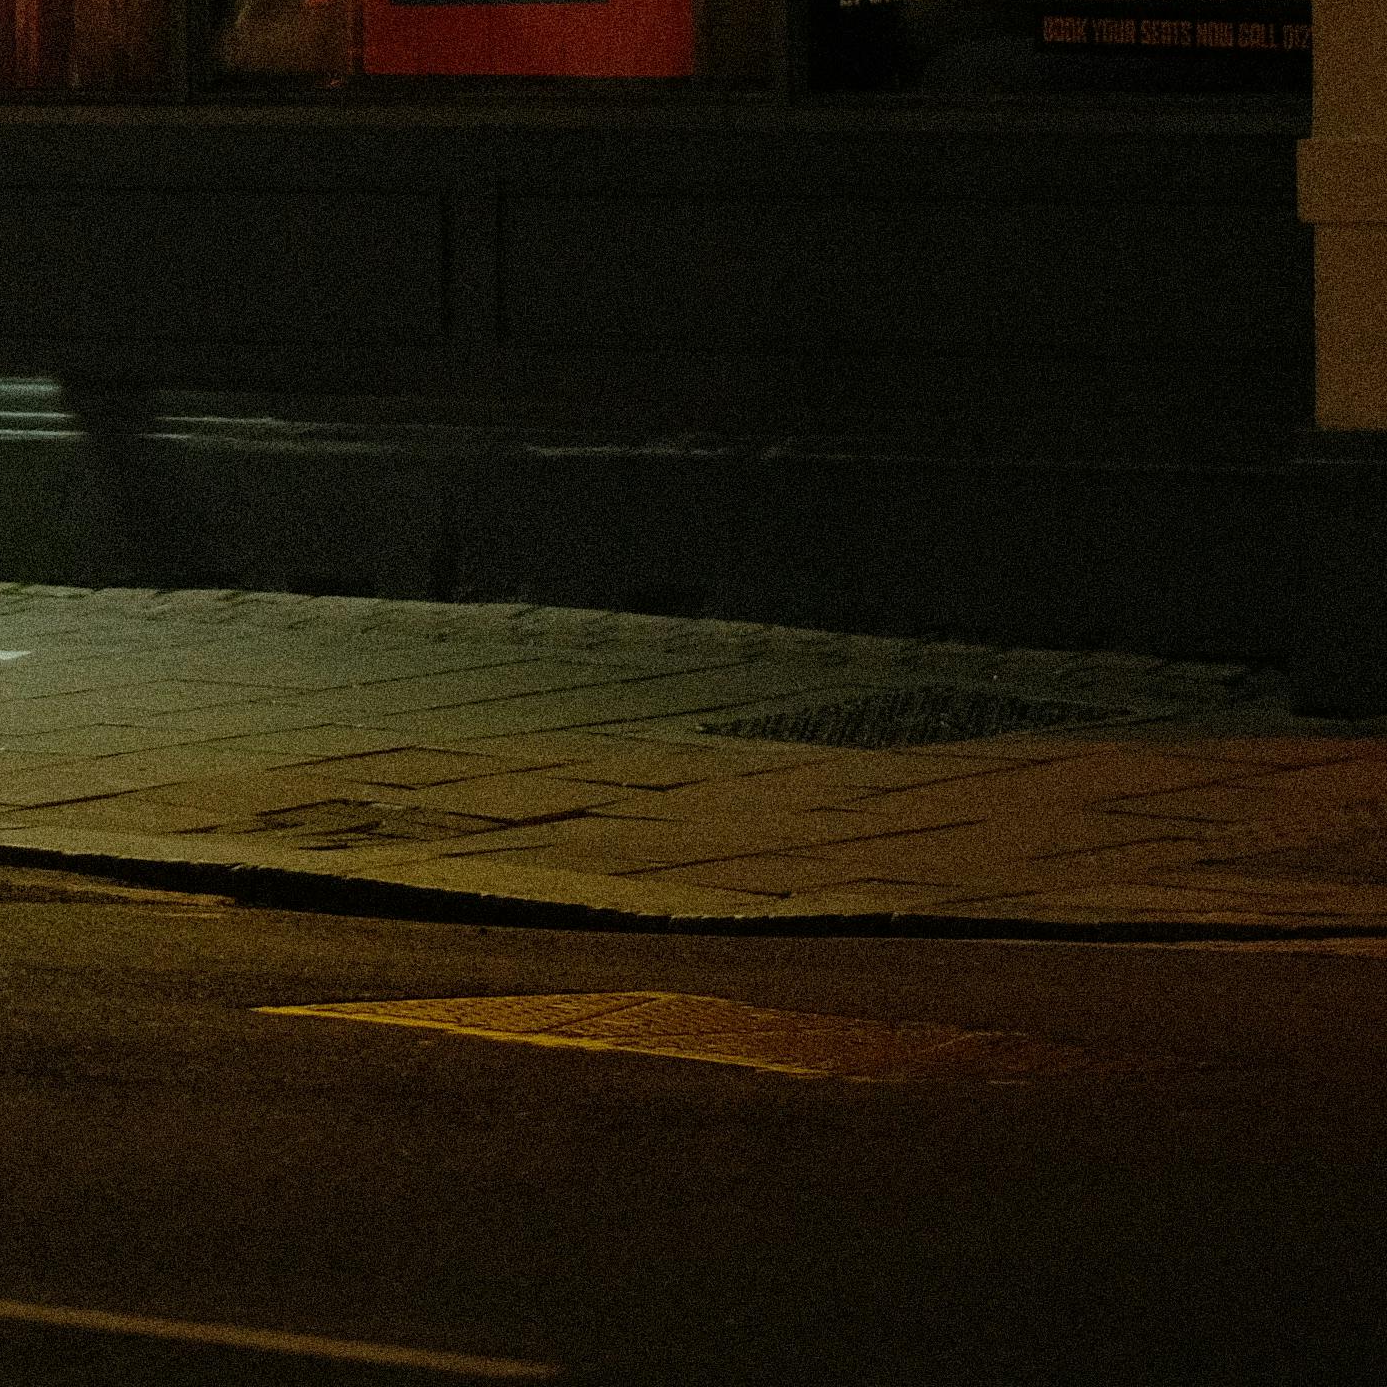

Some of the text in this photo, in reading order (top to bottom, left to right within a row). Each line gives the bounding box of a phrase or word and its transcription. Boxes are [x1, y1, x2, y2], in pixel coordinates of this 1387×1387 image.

[1043, 15, 1088, 44] BOOK
[1091, 17, 1137, 45] YOUR
[1140, 19, 1192, 47] SEATS
[1195, 20, 1235, 48] NOW
[1237, 22, 1280, 49] CALL
